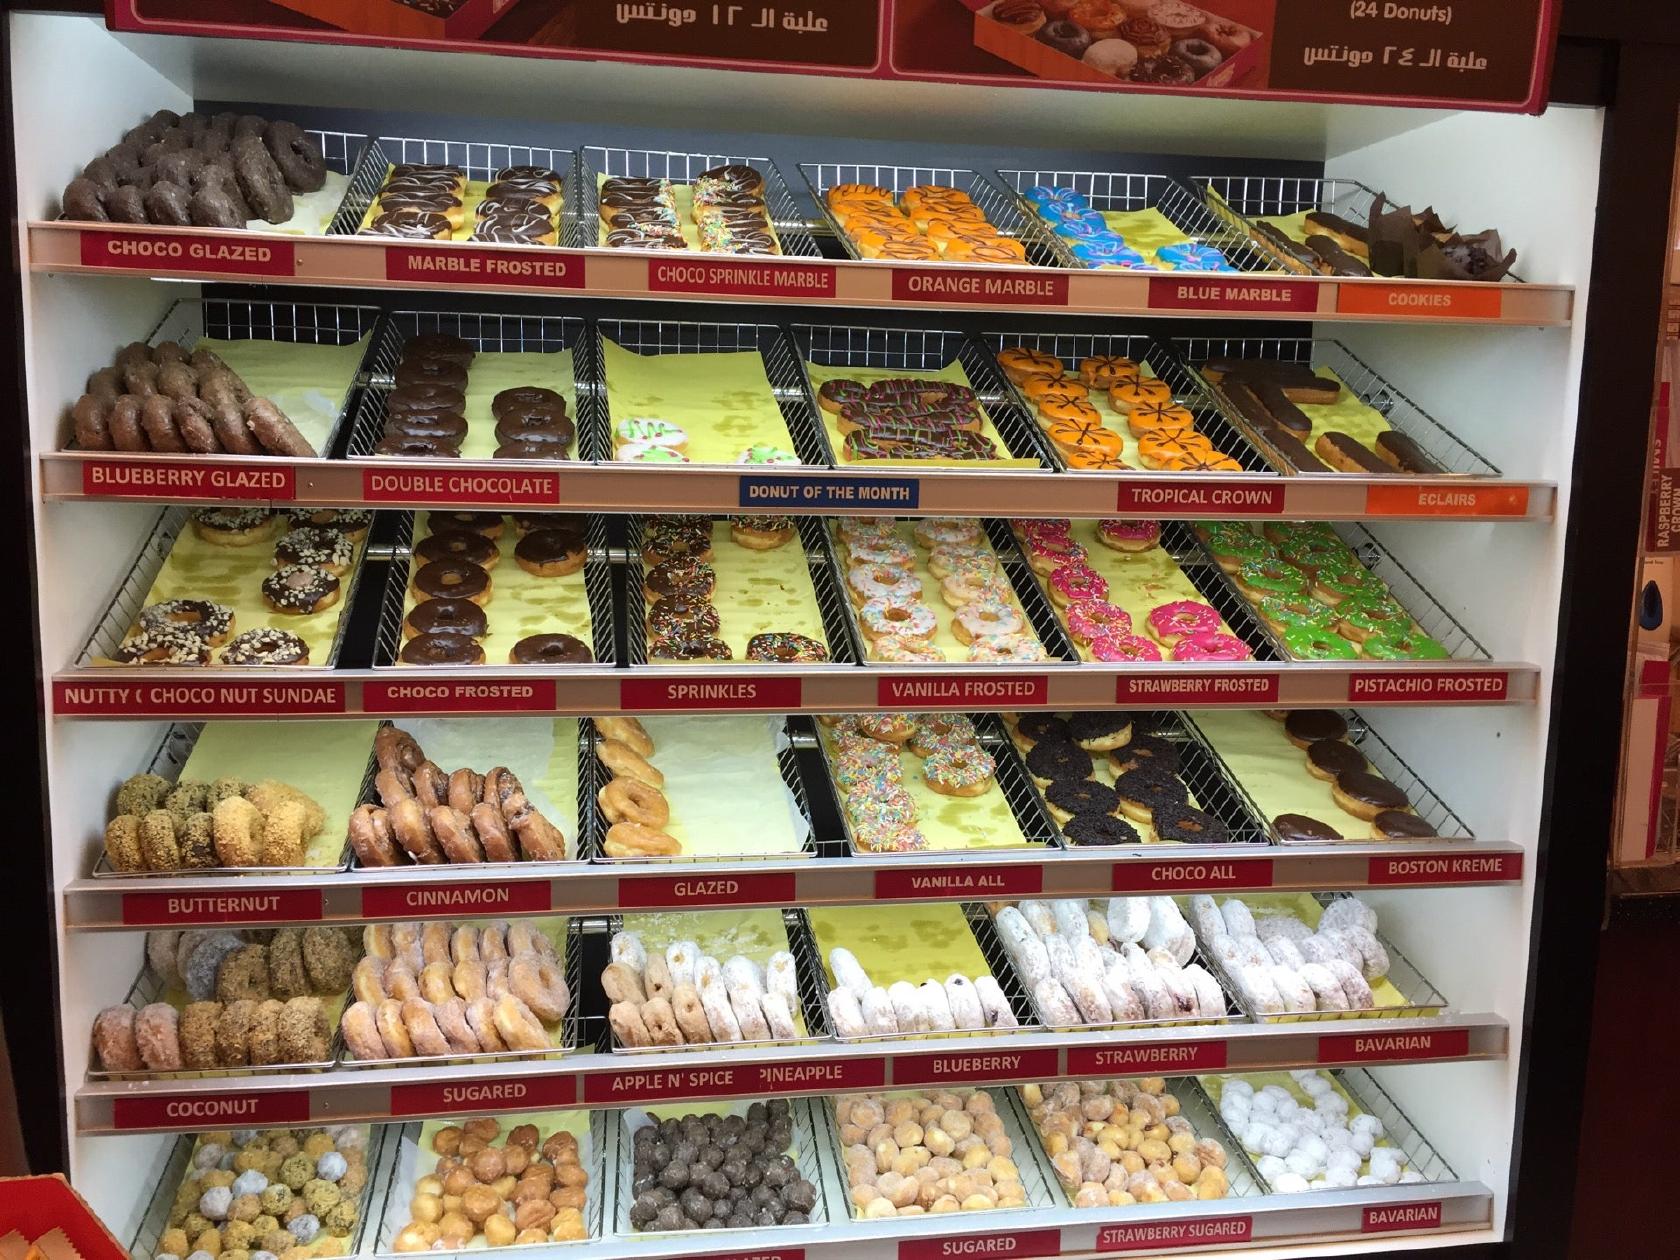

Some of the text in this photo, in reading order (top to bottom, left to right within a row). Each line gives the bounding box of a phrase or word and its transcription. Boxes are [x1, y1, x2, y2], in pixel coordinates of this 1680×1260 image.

[1350, 0, 1452, 25] (24 Donuts)
[107, 240, 272, 262] CHOCO GLAZED
[407, 255, 567, 277] MARBLE FROSTED
[657, 266, 829, 289] CHOCO SPRINKLE MARBLE
[908, 276, 1054, 296] ORANGE MARBLE
[1177, 286, 1292, 302] BLUE MARBLE
[1388, 293, 1452, 307] COOKIES
[91, 467, 286, 489] BLUEBERRY GLAZED
[371, 475, 553, 494] DOUBLE CHOCOLATE
[749, 485, 910, 500] DONUT OF THE MONTH
[1131, 488, 1273, 505] TROPICAL CROWN
[1418, 493, 1476, 506] ECLAIRS
[1656, 475, 1672, 547] RASPBERRY
[387, 686, 534, 699] CHOCO FROSTED
[667, 684, 757, 699] SPRINKLES
[892, 681, 1035, 697] VANILLA FROSTED
[1129, 678, 1269, 693] STRAWBERRY FROSTED
[1354, 678, 1503, 693] PISTACHIO FROSTED
[65, 688, 130, 704] NUTTY
[150, 688, 215, 703] CHOCO
[220, 688, 258, 703] NUT
[263, 688, 336, 704] SUNDAE
[1151, 866, 1236, 881] CHOCO ALL
[1388, 858, 1503, 875] BOSTON KREME
[674, 880, 739, 896] GLAZED
[911, 875, 1005, 889] VANILLA ALL
[168, 896, 280, 913] BUTTERNUT
[406, 888, 509, 906] CINNAMON
[1355, 1035, 1431, 1052] BAVARIAN
[933, 1055, 1021, 1074] BLUEBERRY
[1095, 1047, 1198, 1066] STRAWBERRY
[611, 1070, 734, 1091] APPLE N' SPICE
[443, 1083, 527, 1102] SUGARED
[166, 1099, 259, 1117] COCONUT
[1369, 1206, 1438, 1224] BAVARIAN
[1103, 1221, 1246, 1244] STRAWBERRY SUGARED
[942, 1237, 1017, 1256] SUGARED
